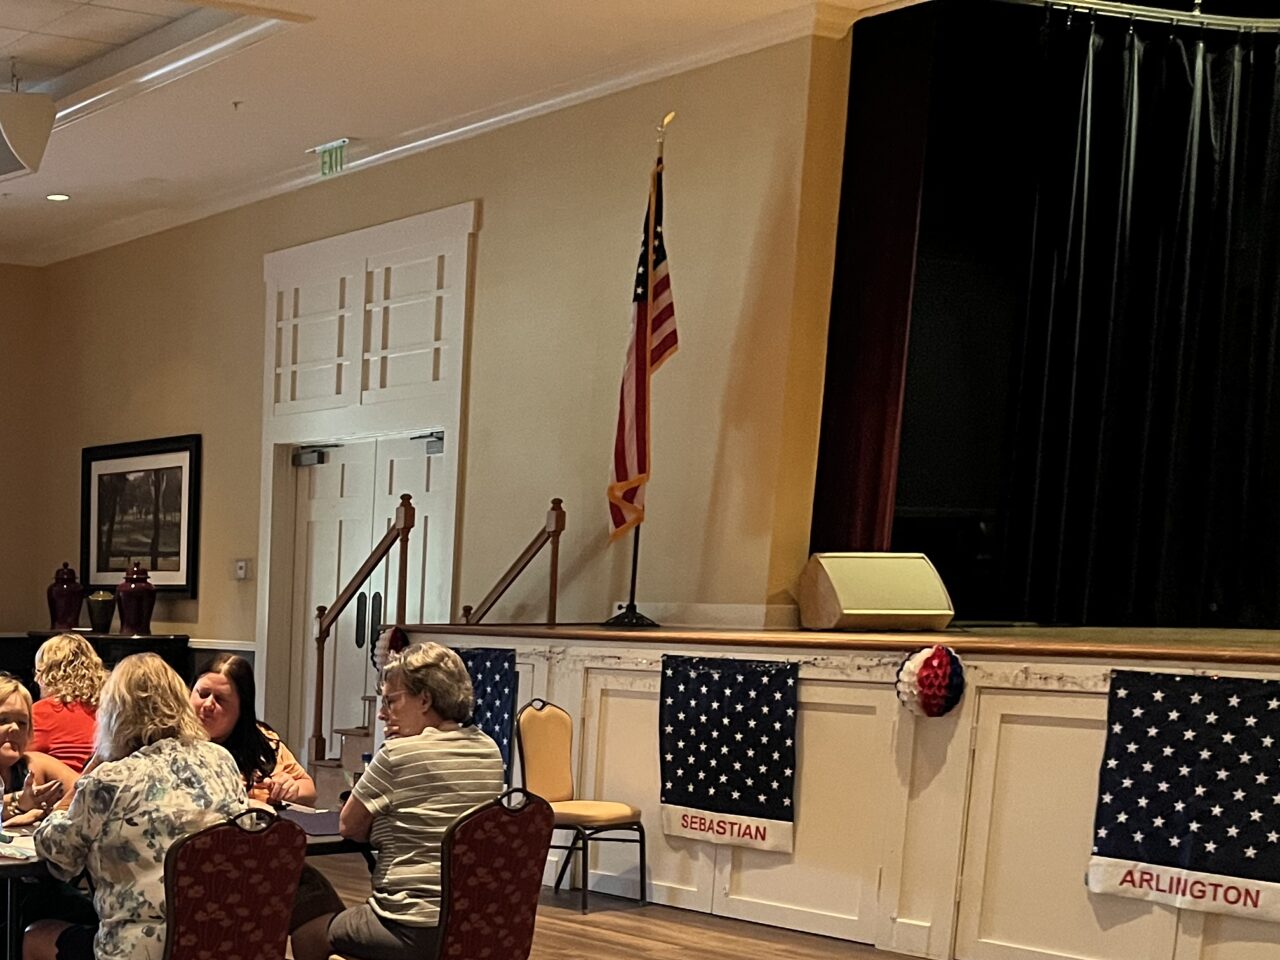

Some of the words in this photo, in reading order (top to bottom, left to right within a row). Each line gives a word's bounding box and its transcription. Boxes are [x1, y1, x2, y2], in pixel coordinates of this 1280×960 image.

[321, 146, 344, 176] EXIT
[681, 814, 767, 841] SEBASTIAN
[1118, 869, 1261, 909] ARLINGTON
